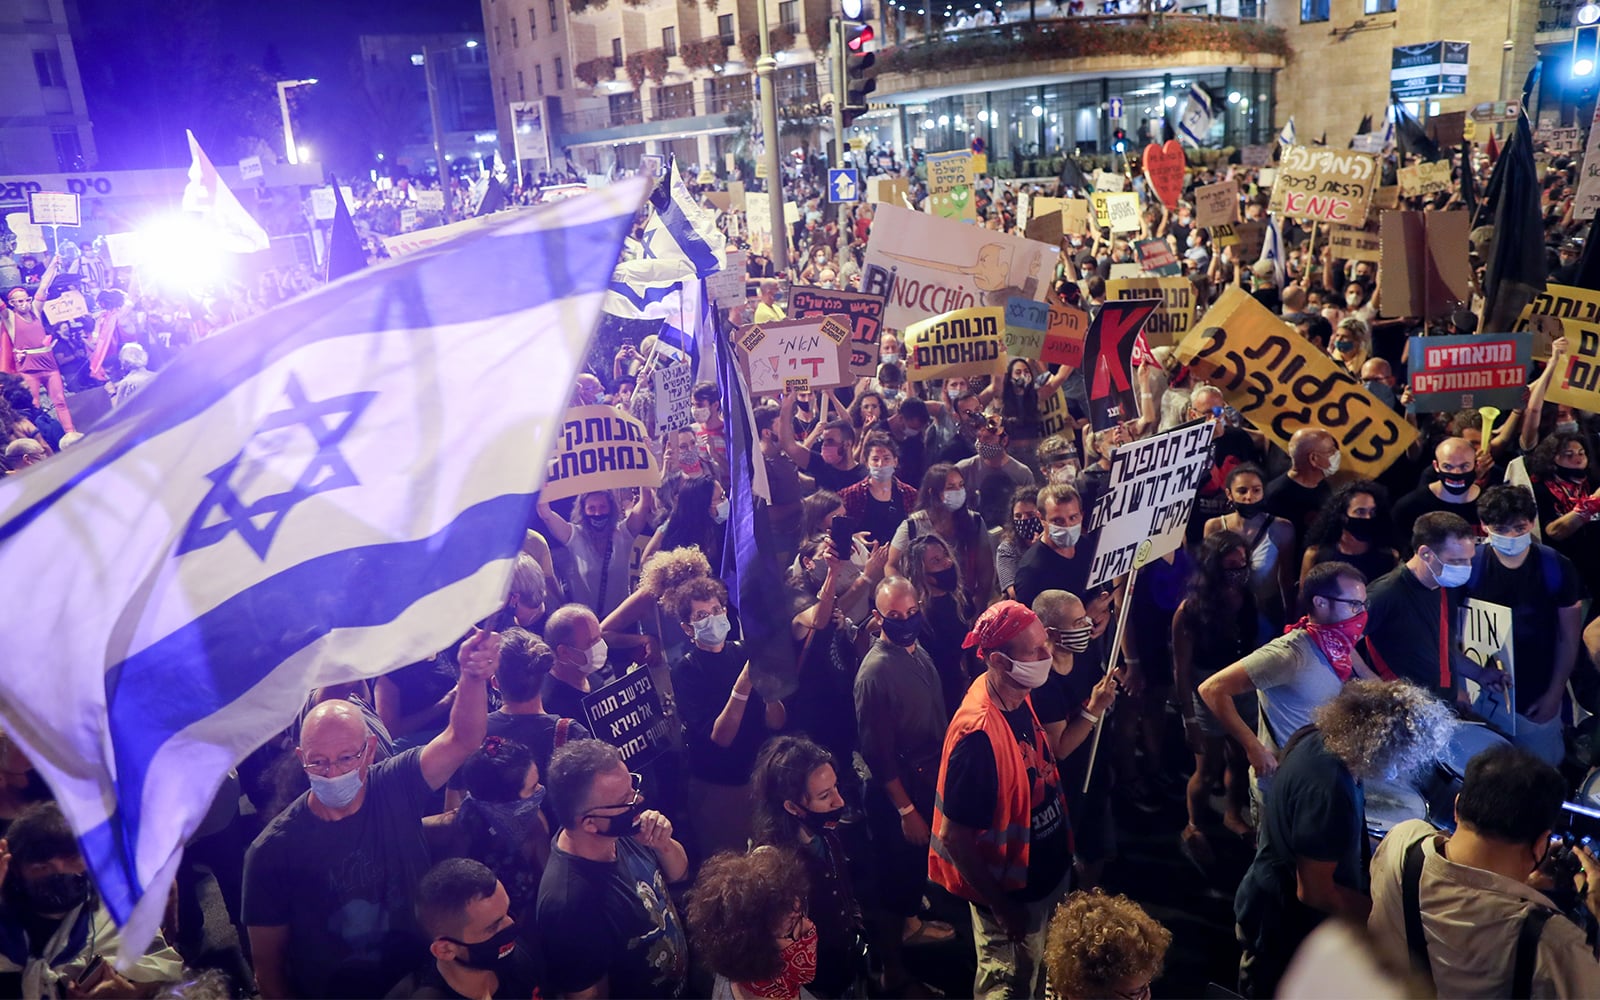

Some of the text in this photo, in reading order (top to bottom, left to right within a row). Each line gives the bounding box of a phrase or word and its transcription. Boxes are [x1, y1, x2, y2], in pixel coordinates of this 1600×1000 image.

[1285, 192, 1350, 220] אמא
[796, 295, 881, 314] ראש ממשלה
[1428, 343, 1513, 368] מתאחדים
[1188, 326, 1338, 448] גידה?
[1415, 367, 1523, 393] נגד המנותקים
[1243, 335, 1399, 463] צוללות
[557, 417, 645, 452] מנותק
[1127, 470, 1176, 514] דורש
[590, 676, 653, 721] ביבי שב תנוח
[637, 702, 654, 721] אל
[609, 711, 642, 739] תירא
[618, 734, 649, 761] בחזר
